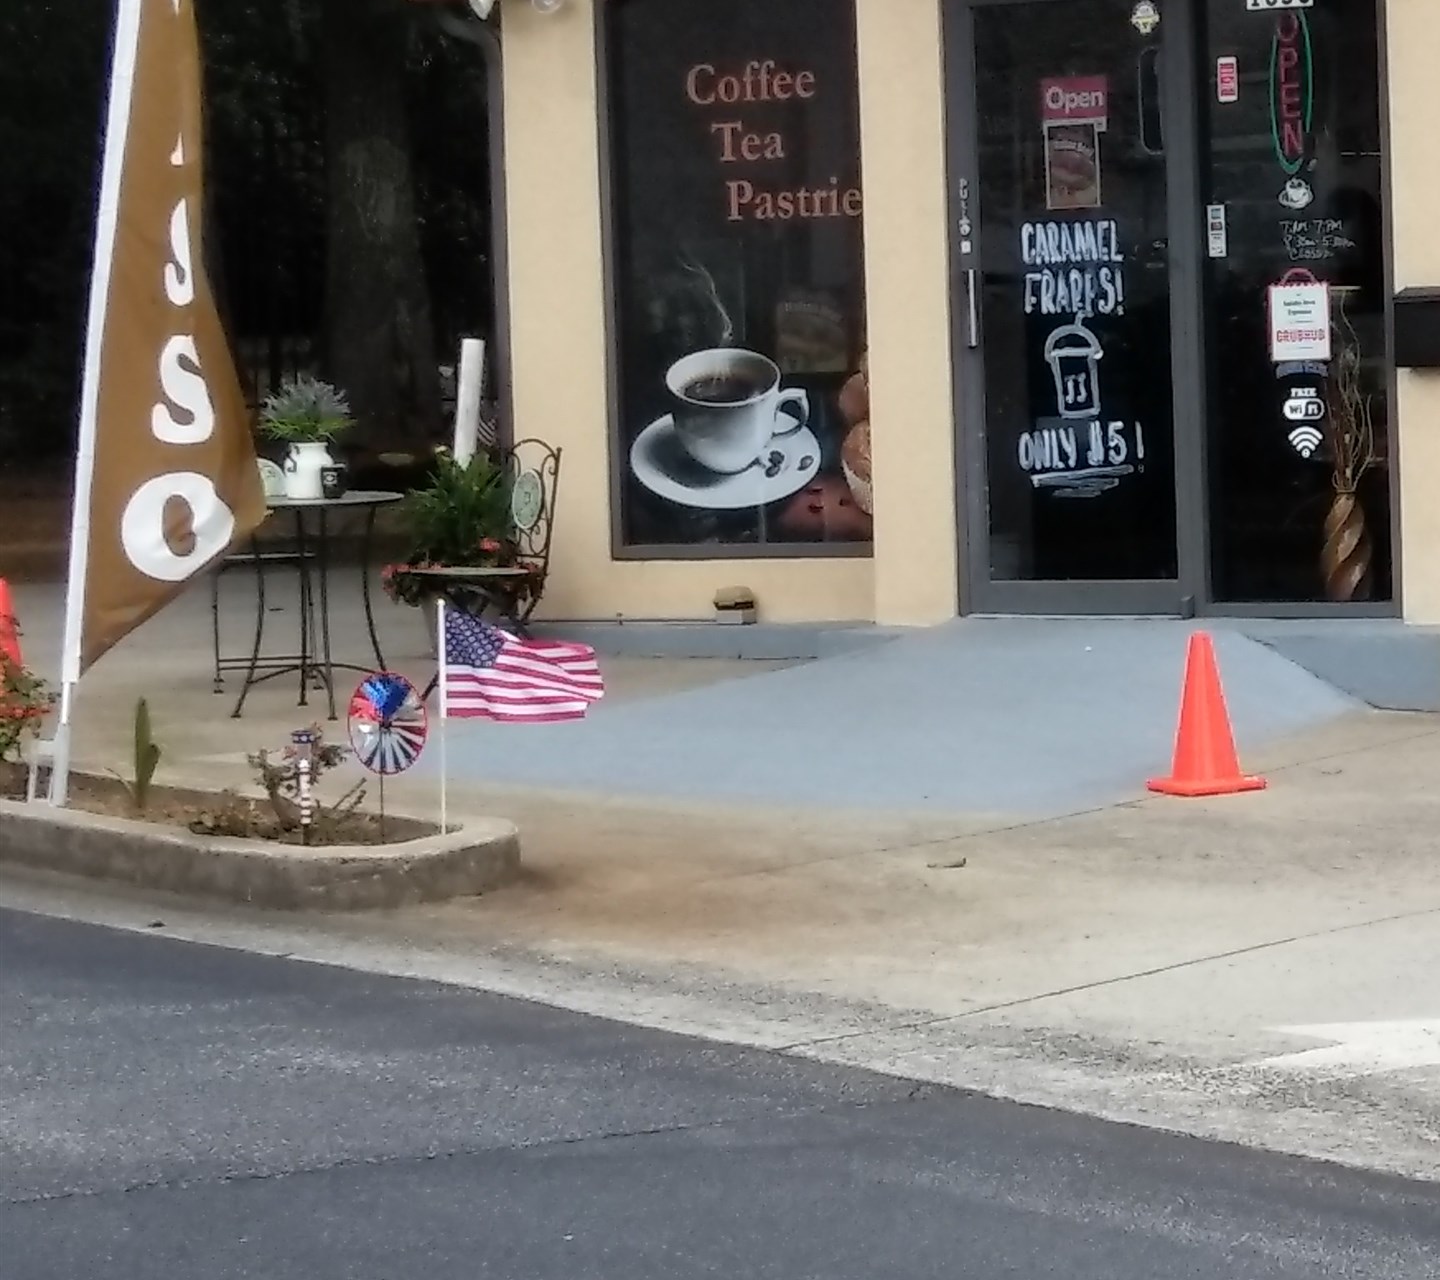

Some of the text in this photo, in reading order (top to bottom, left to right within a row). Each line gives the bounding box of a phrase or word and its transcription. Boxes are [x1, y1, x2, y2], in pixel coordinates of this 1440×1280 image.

[685, 59, 817, 106] Coffee
[1045, 85, 1105, 114] Open
[1276, 9, 1304, 157] OPEN
[710, 120, 786, 163] Tea
[1020, 220, 1125, 266] CARAMEL
[1018, 426, 1077, 471] ONLY
